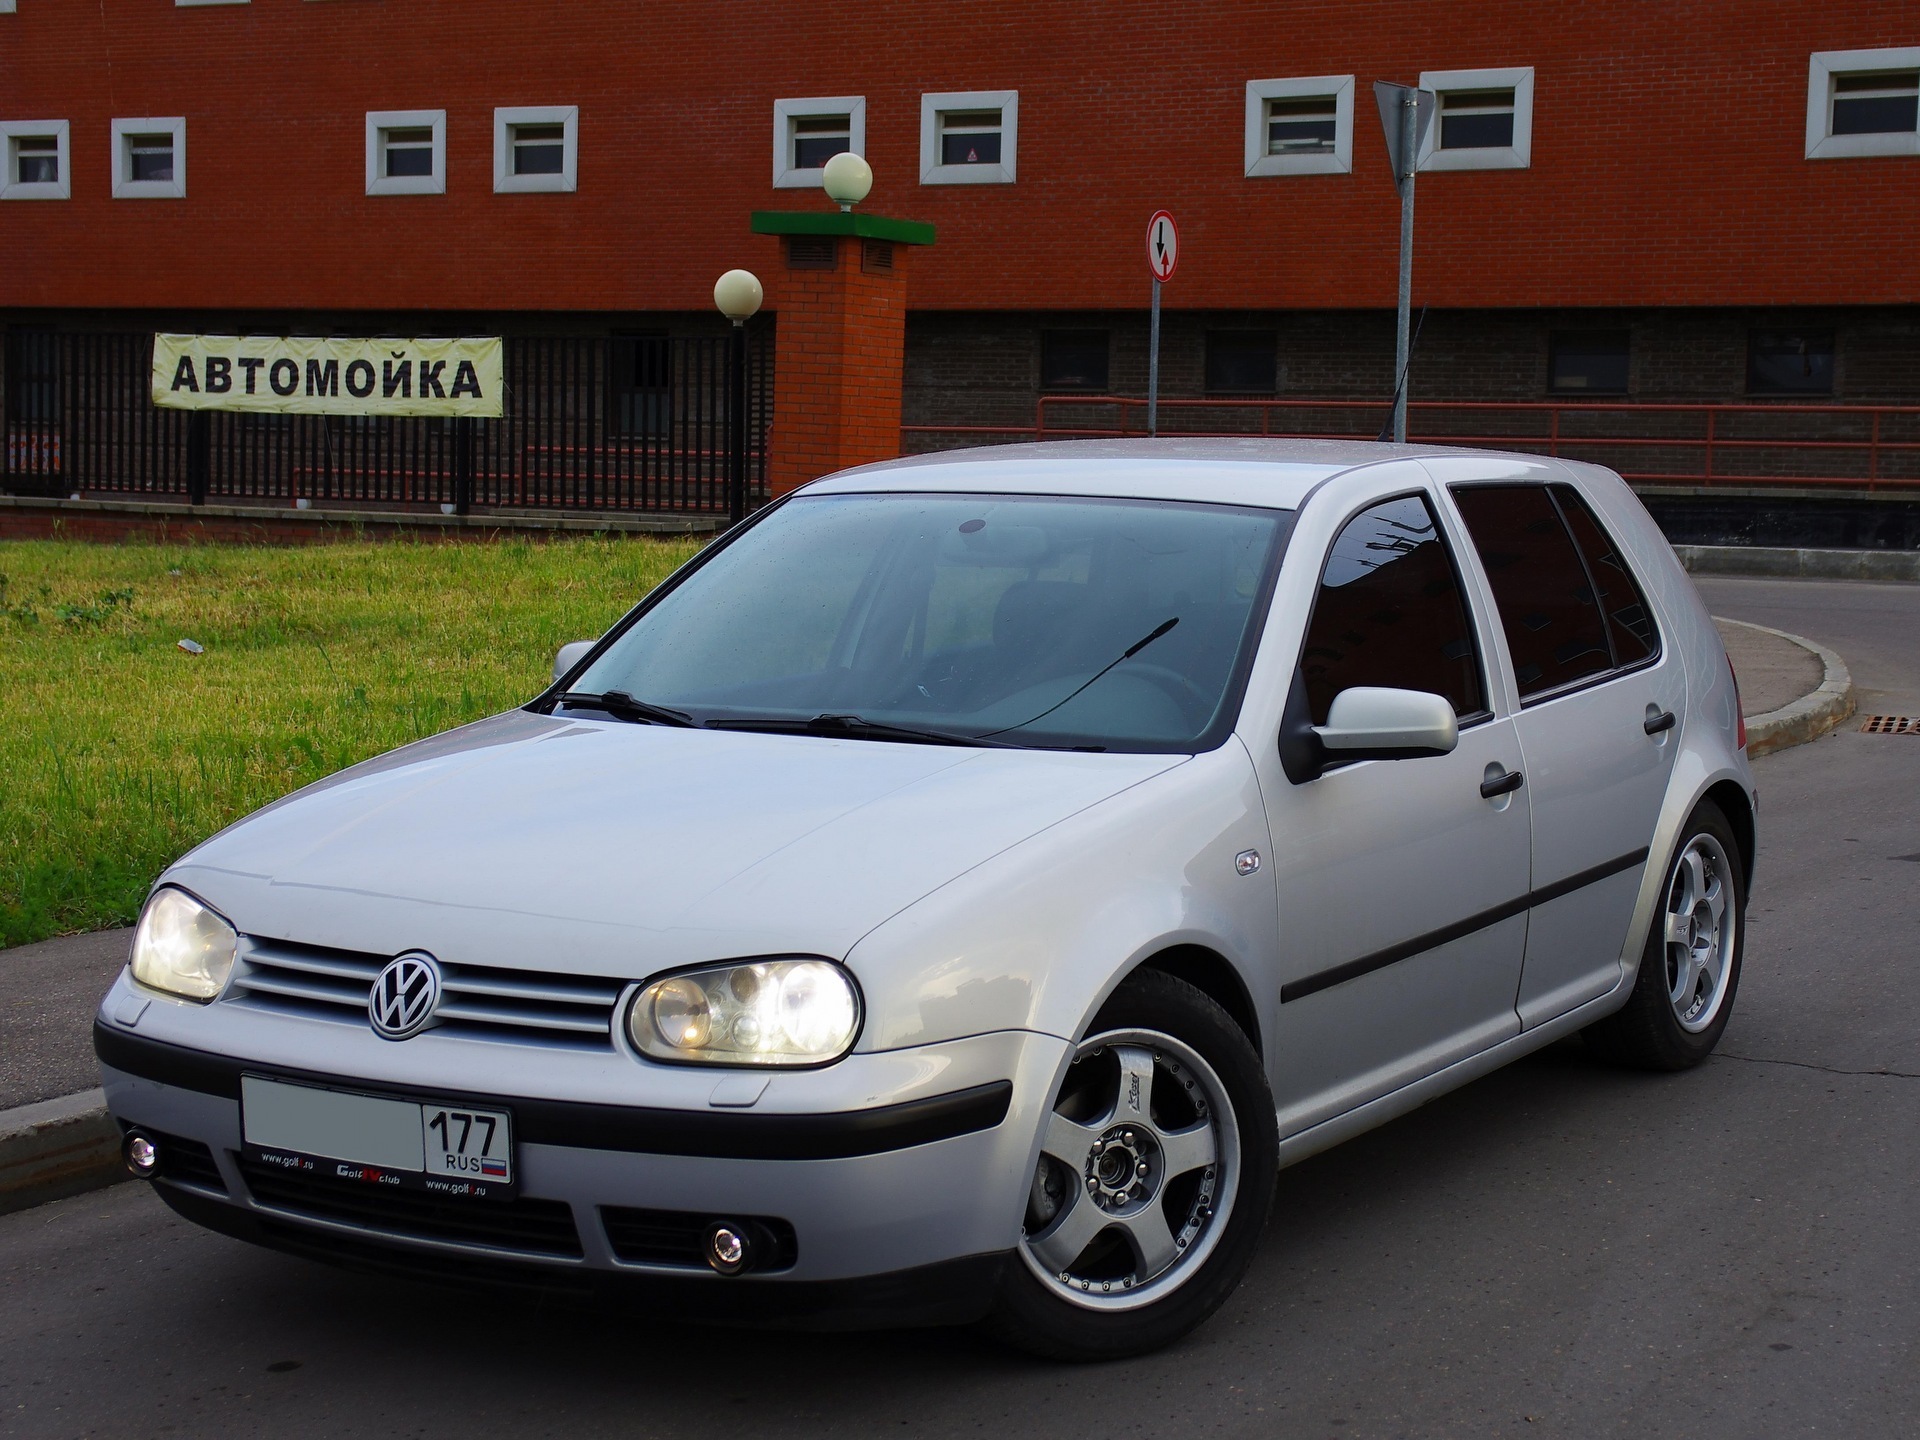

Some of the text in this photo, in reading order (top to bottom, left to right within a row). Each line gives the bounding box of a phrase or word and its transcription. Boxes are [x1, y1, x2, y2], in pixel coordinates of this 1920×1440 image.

[170, 351, 483, 398] АВТОМОЙКА
[371, 956, 437, 1034] VW
[429, 1110, 497, 1157] 177
[445, 1153, 480, 1172] RUS
